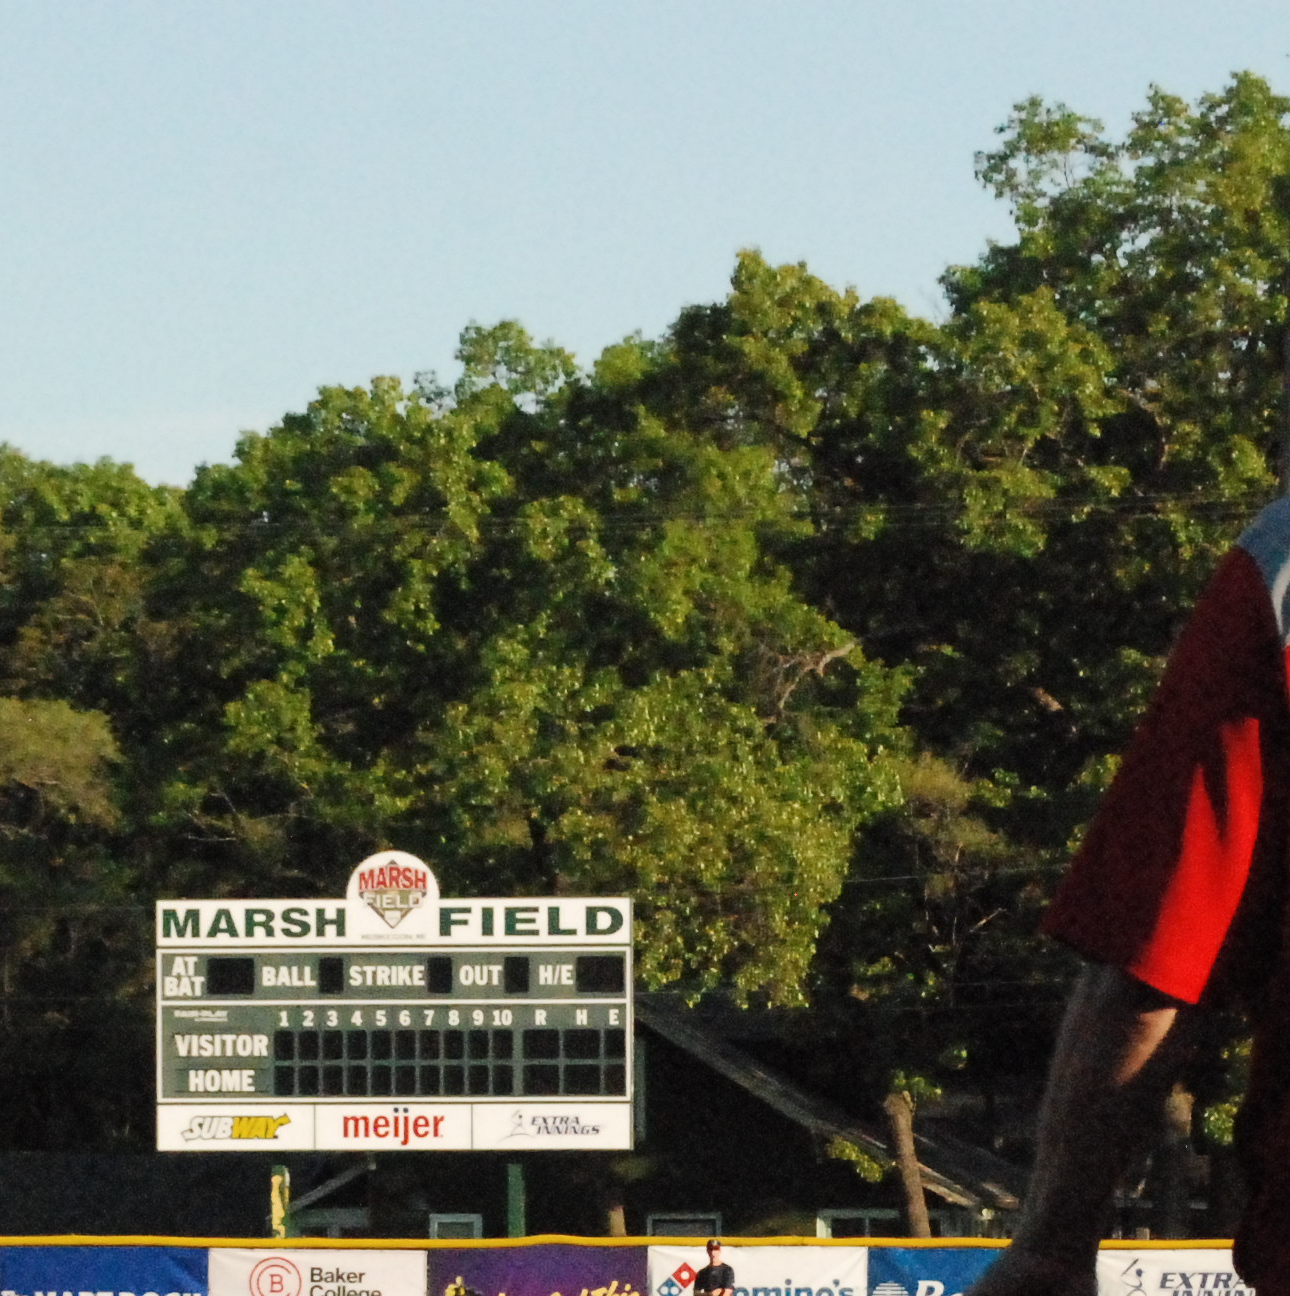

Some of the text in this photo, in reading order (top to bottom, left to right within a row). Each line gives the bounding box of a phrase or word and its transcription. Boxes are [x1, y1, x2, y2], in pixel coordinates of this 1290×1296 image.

[359, 866, 427, 891] MARSH
[362, 893, 423, 909] FIELD
[162, 906, 624, 938] MARSH FIELD
[171, 956, 199, 977] AT
[262, 965, 317, 987] BALL
[349, 965, 425, 987] STRIKE
[459, 964, 503, 986] OUT
[538, 963, 574, 985] H/E
[164, 976, 205, 997] BAT
[279, 1009, 620, 1027] 1 2 3 4 5 6 7 8 9 10 R H E
[174, 1034, 269, 1057] VISITOR
[188, 1070, 256, 1092] HOME
[181, 1113, 291, 1142] SUBWAY
[343, 1107, 445, 1145] meijer
[531, 1115, 580, 1126] EXTRA
[536, 1125, 601, 1136] INNINGS
[310, 1267, 366, 1284] Baker
